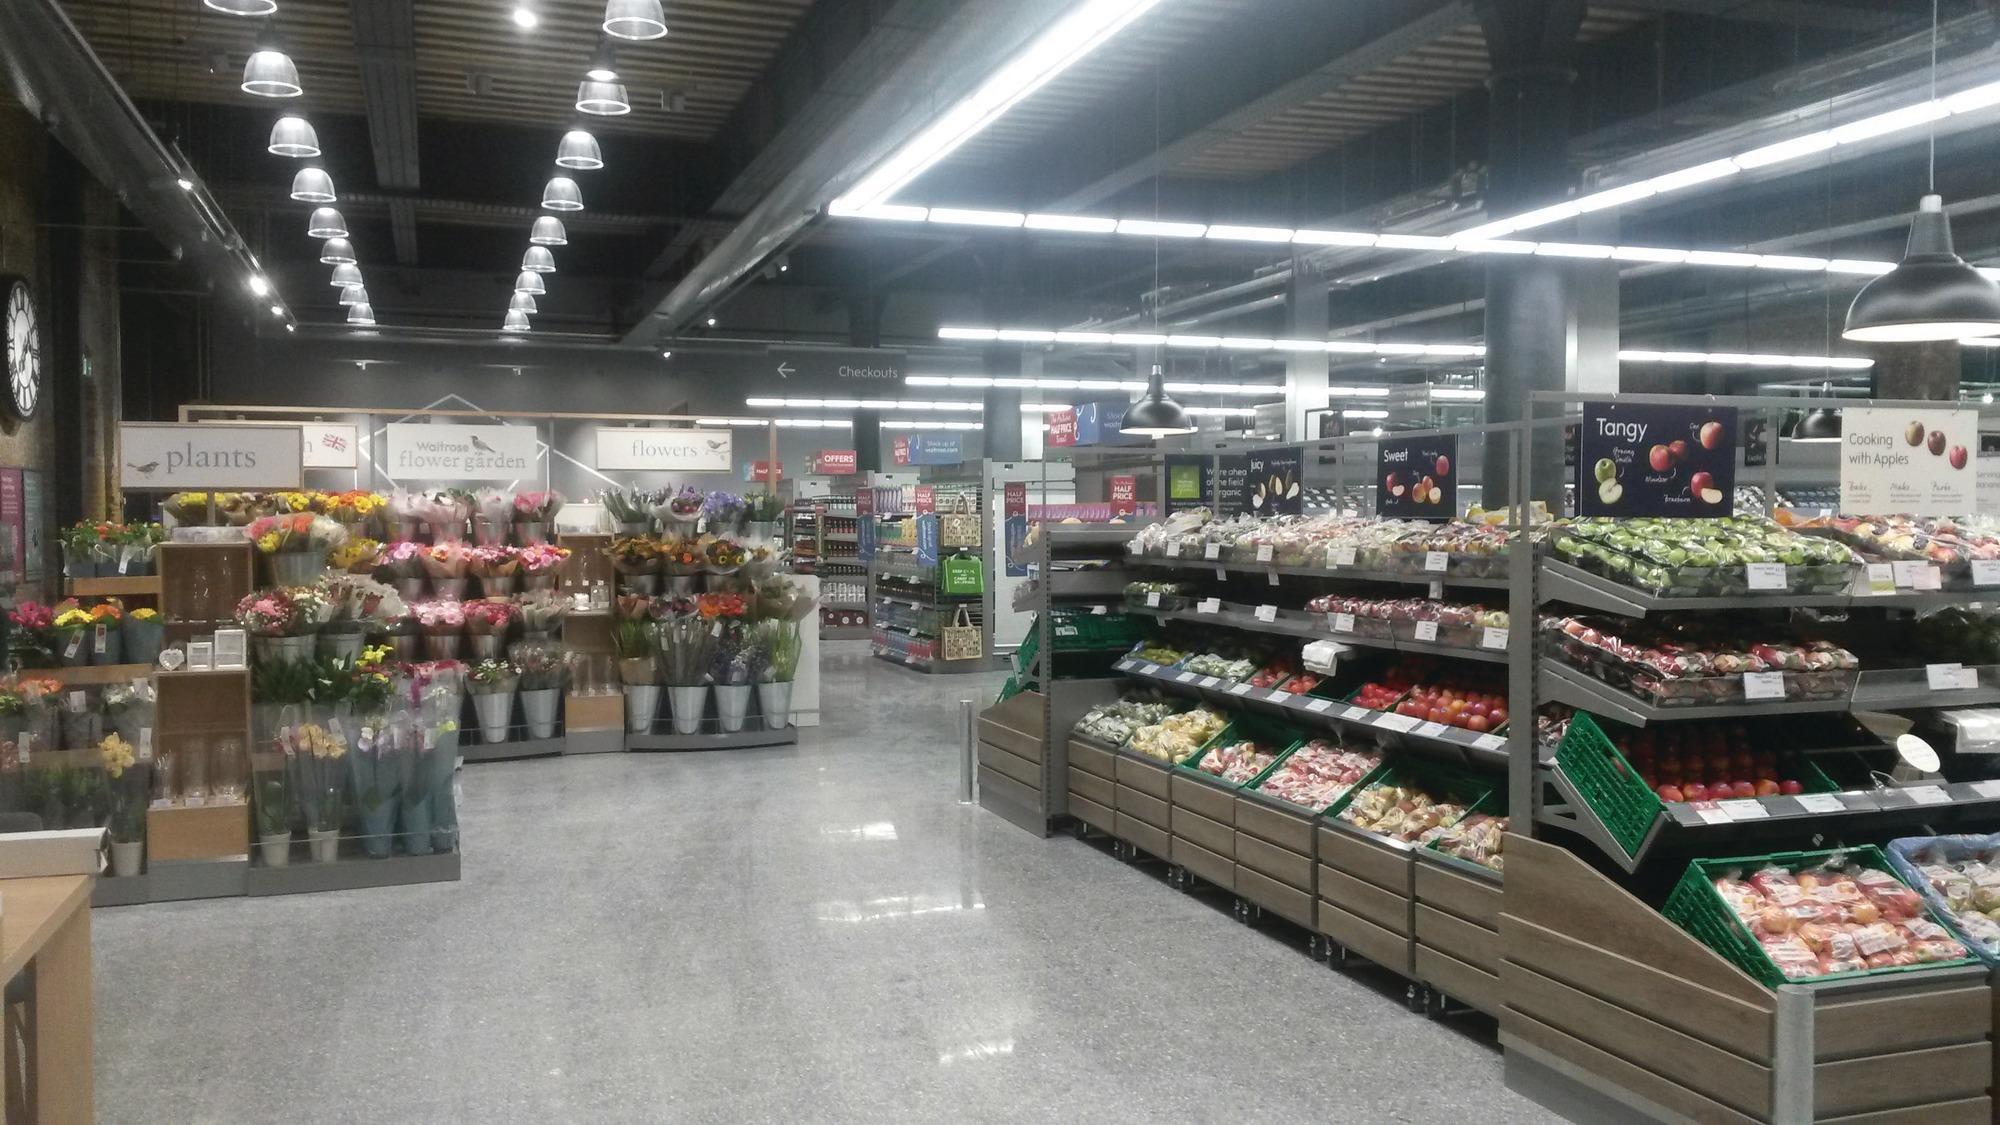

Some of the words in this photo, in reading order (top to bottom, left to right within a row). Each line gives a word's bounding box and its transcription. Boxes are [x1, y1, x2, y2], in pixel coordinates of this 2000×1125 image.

[838, 365, 898, 378] Checkouts
[1596, 417, 1648, 443] Tangy
[416, 440, 469, 452] Waitrose
[1849, 432, 1893, 449] Cooking
[631, 438, 698, 457] flowers
[166, 441, 256, 474] plants
[399, 450, 460, 468] flower
[464, 452, 526, 473] garden
[824, 454, 854, 463] OFFERS
[1384, 448, 1408, 462] Sweet
[1849, 451, 1871, 464] with
[1873, 451, 1909, 469] Apples
[1228, 468, 1247, 476] ahea
[1228, 478, 1244, 486] field
[1112, 492, 1134, 500] PRICE
[1219, 488, 1242, 498] rganic
